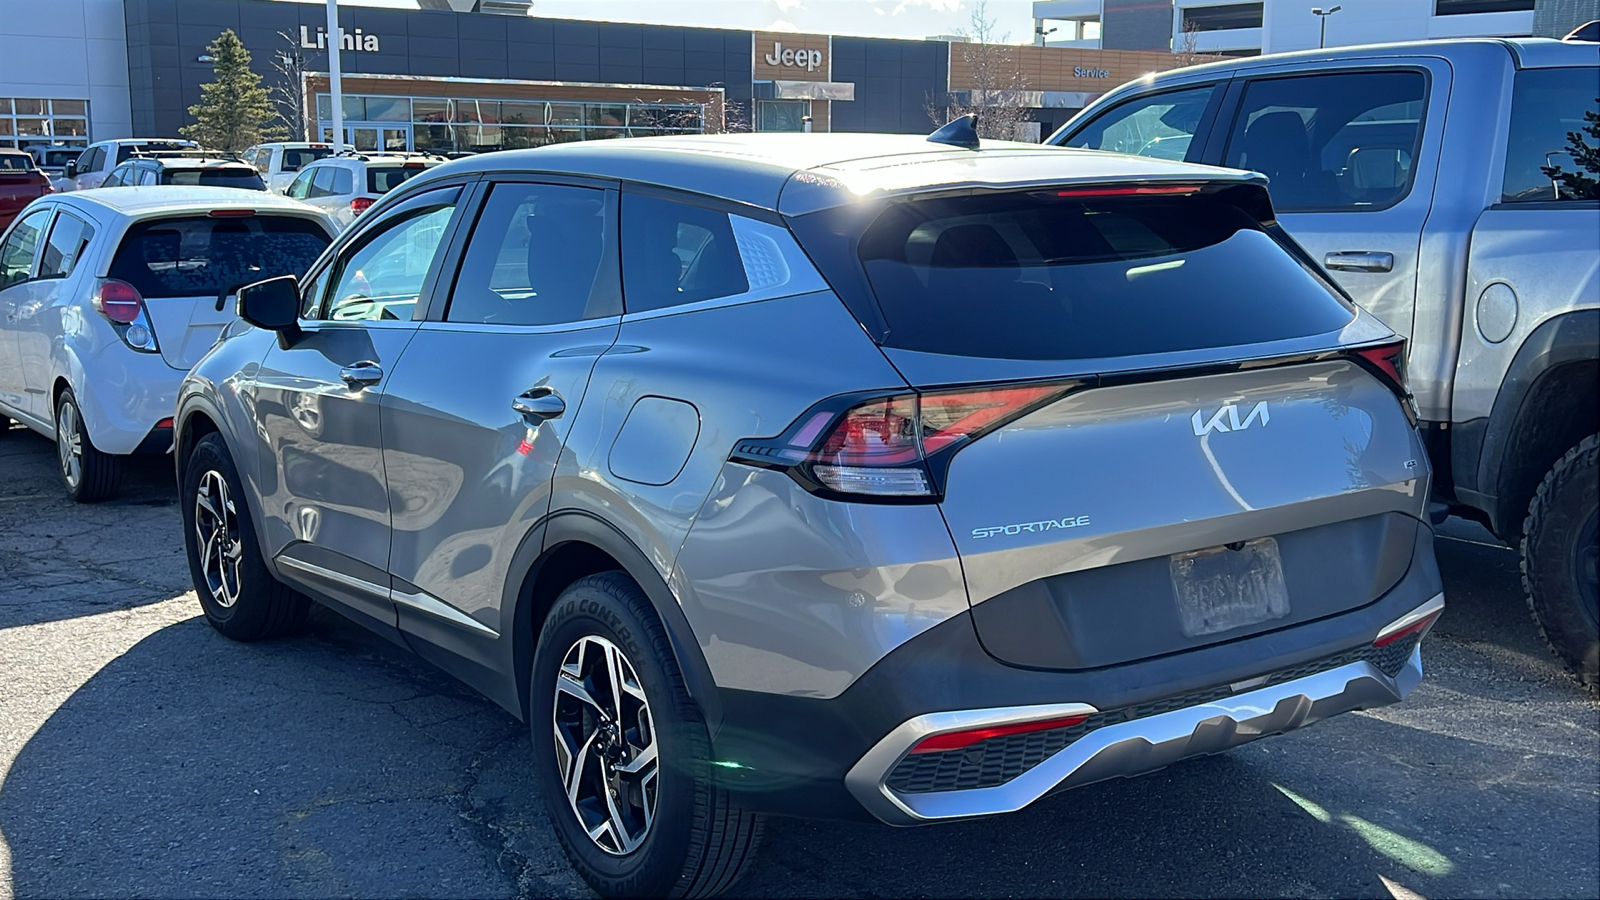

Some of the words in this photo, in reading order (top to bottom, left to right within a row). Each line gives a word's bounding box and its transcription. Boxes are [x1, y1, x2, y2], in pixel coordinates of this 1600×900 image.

[300, 25, 379, 52] Lihia
[765, 41, 822, 73] Jeep
[1073, 66, 1109, 78] Service
[1191, 400, 1270, 436] KIA
[971, 515, 1091, 539] SPORTAGE
